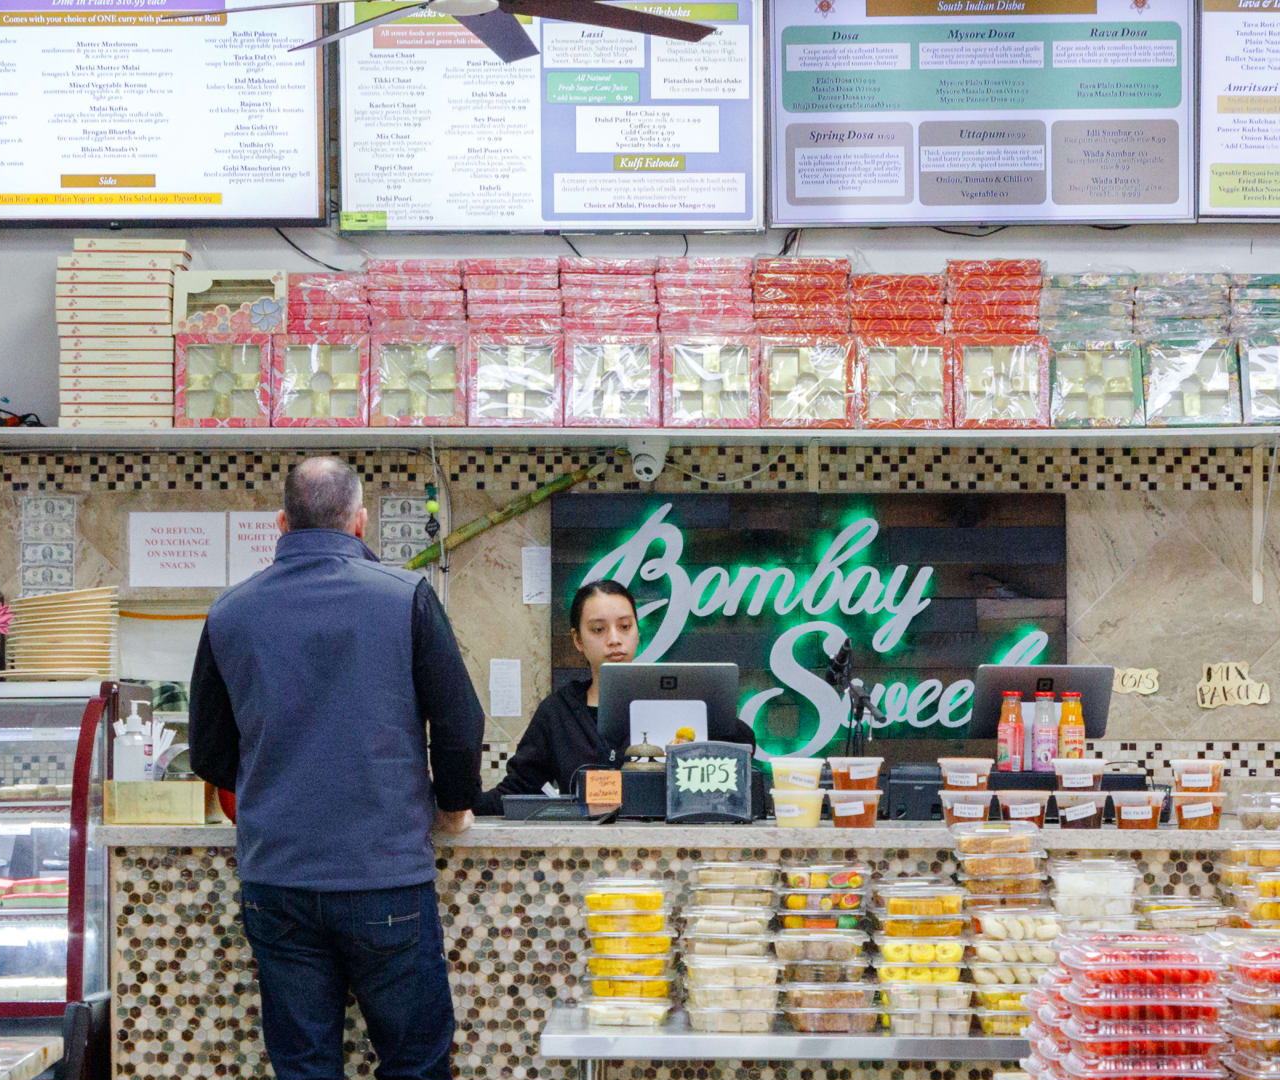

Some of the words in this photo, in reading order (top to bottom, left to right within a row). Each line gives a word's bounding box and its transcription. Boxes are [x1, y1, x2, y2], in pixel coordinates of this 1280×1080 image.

[937, 1, 963, 11] South
[966, 1, 994, 11] Indian
[997, 0, 1025, 10] Dishes
[3, 15, 28, 23] Comes
[30, 15, 45, 23] with
[46, 16, 62, 24] your
[64, 15, 86, 23] choice
[88, 15, 96, 23] of
[97, 15, 116, 23] ONE
[118, 16, 136, 24] curry
[138, 15, 154, 23] with
[581, 30, 604, 38] Lassi
[832, 31, 859, 40] Dosa
[948, 30, 985, 42] Mysore
[989, 30, 1015, 38] Dosa
[1090, 28, 1118, 37] Rava
[1121, 28, 1147, 37] Dosa
[1224, 83, 1278, 92] Amritsari
[809, 130, 845, 142] Spring
[847, 130, 874, 140] Dosa
[960, 130, 1005, 141] Uttapum
[620, 157, 643, 170] Kulfi
[645, 157, 679, 168] Falooda
[99, 177, 117, 185] Sides
[936, 176, 962, 184] Onion,
[961, 191, 997, 199] Vegetable
[580, 502, 934, 665] Bombay
[1205, 666, 1246, 682] MIX
[1199, 685, 1265, 704] PAKORA
[682, 764, 729, 783] TIPS
